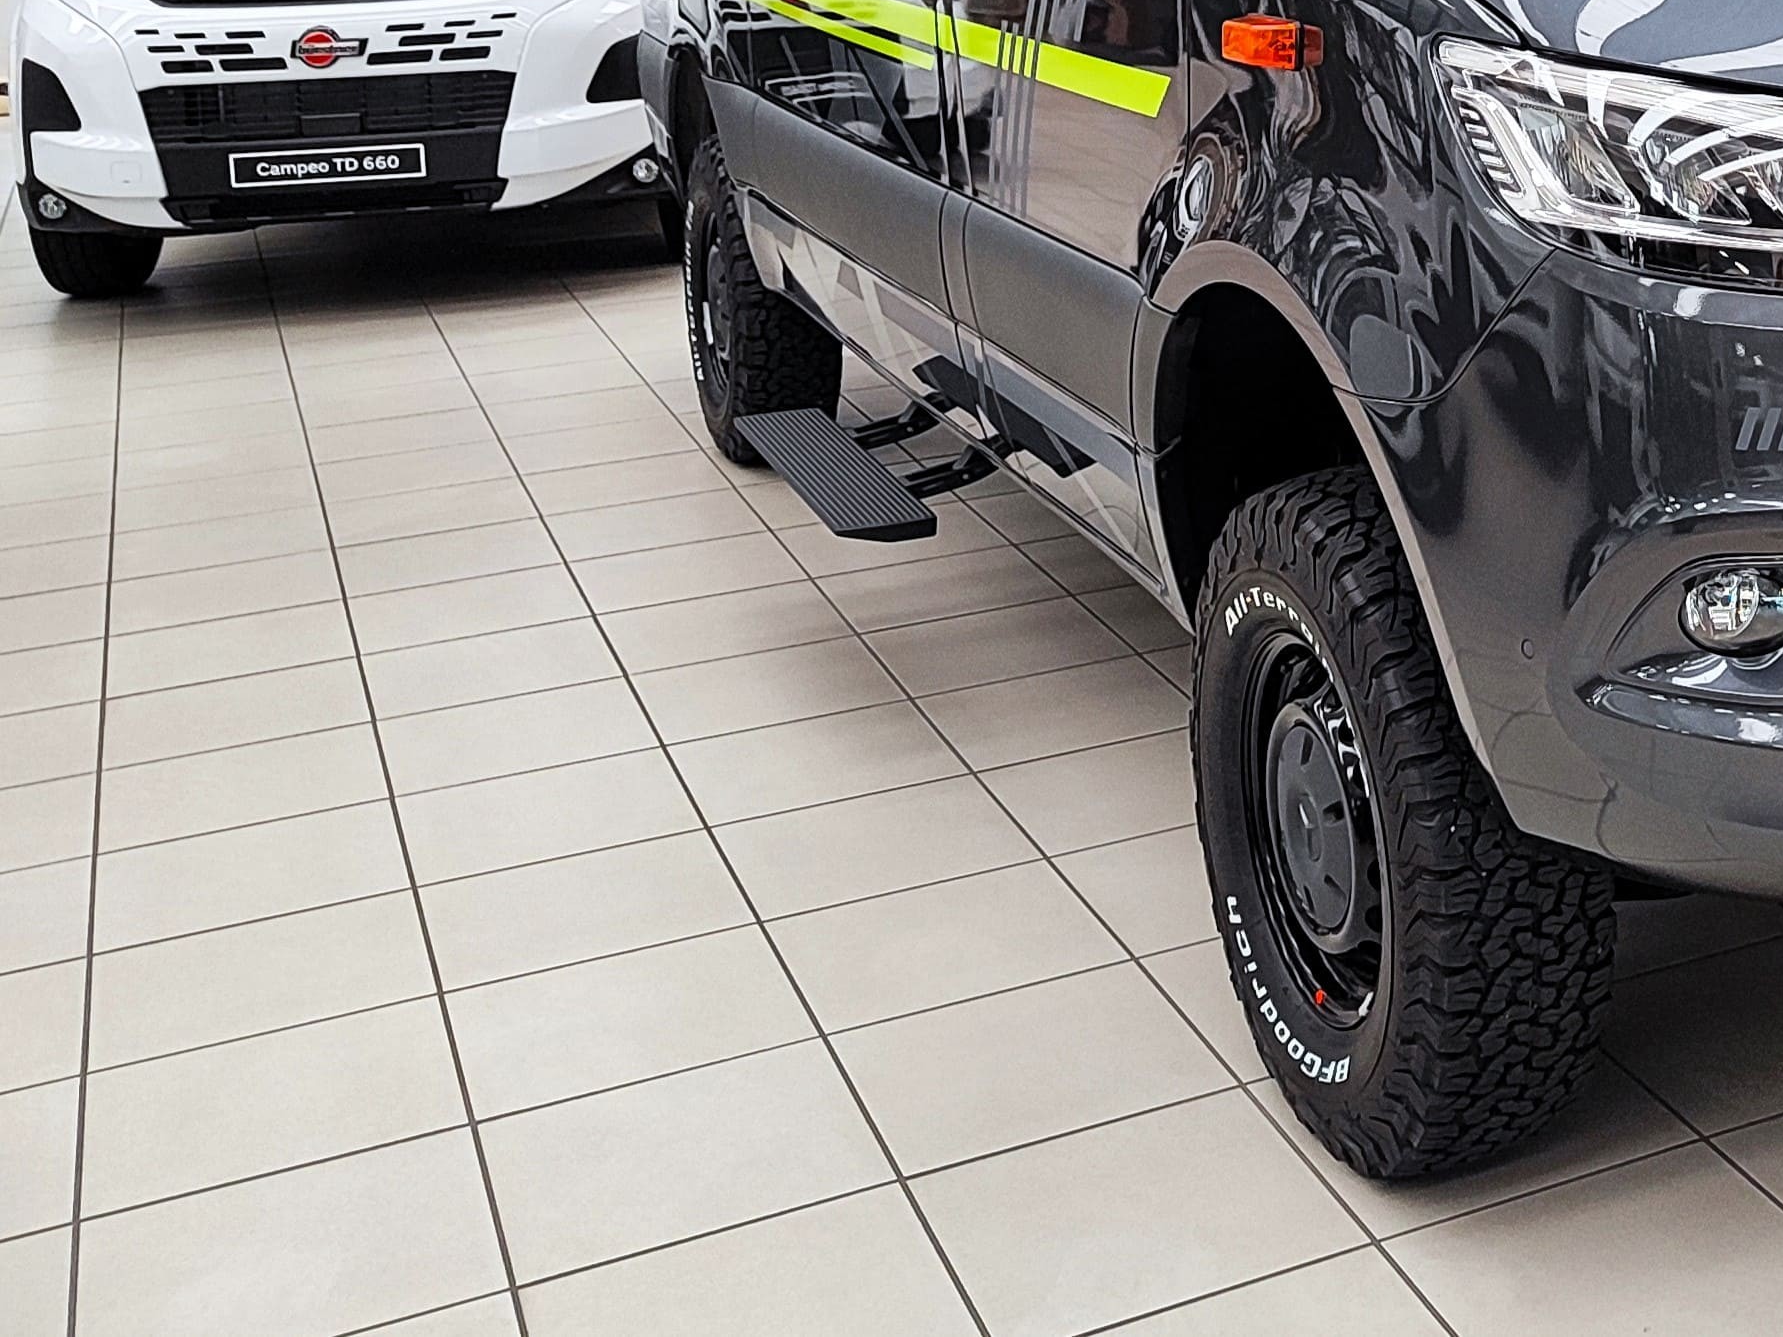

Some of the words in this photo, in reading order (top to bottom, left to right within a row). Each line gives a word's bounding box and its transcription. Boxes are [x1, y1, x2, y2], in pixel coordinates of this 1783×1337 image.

[256, 161, 330, 178] Campeo
[332, 156, 359, 172] TD
[362, 154, 400, 170] 660
